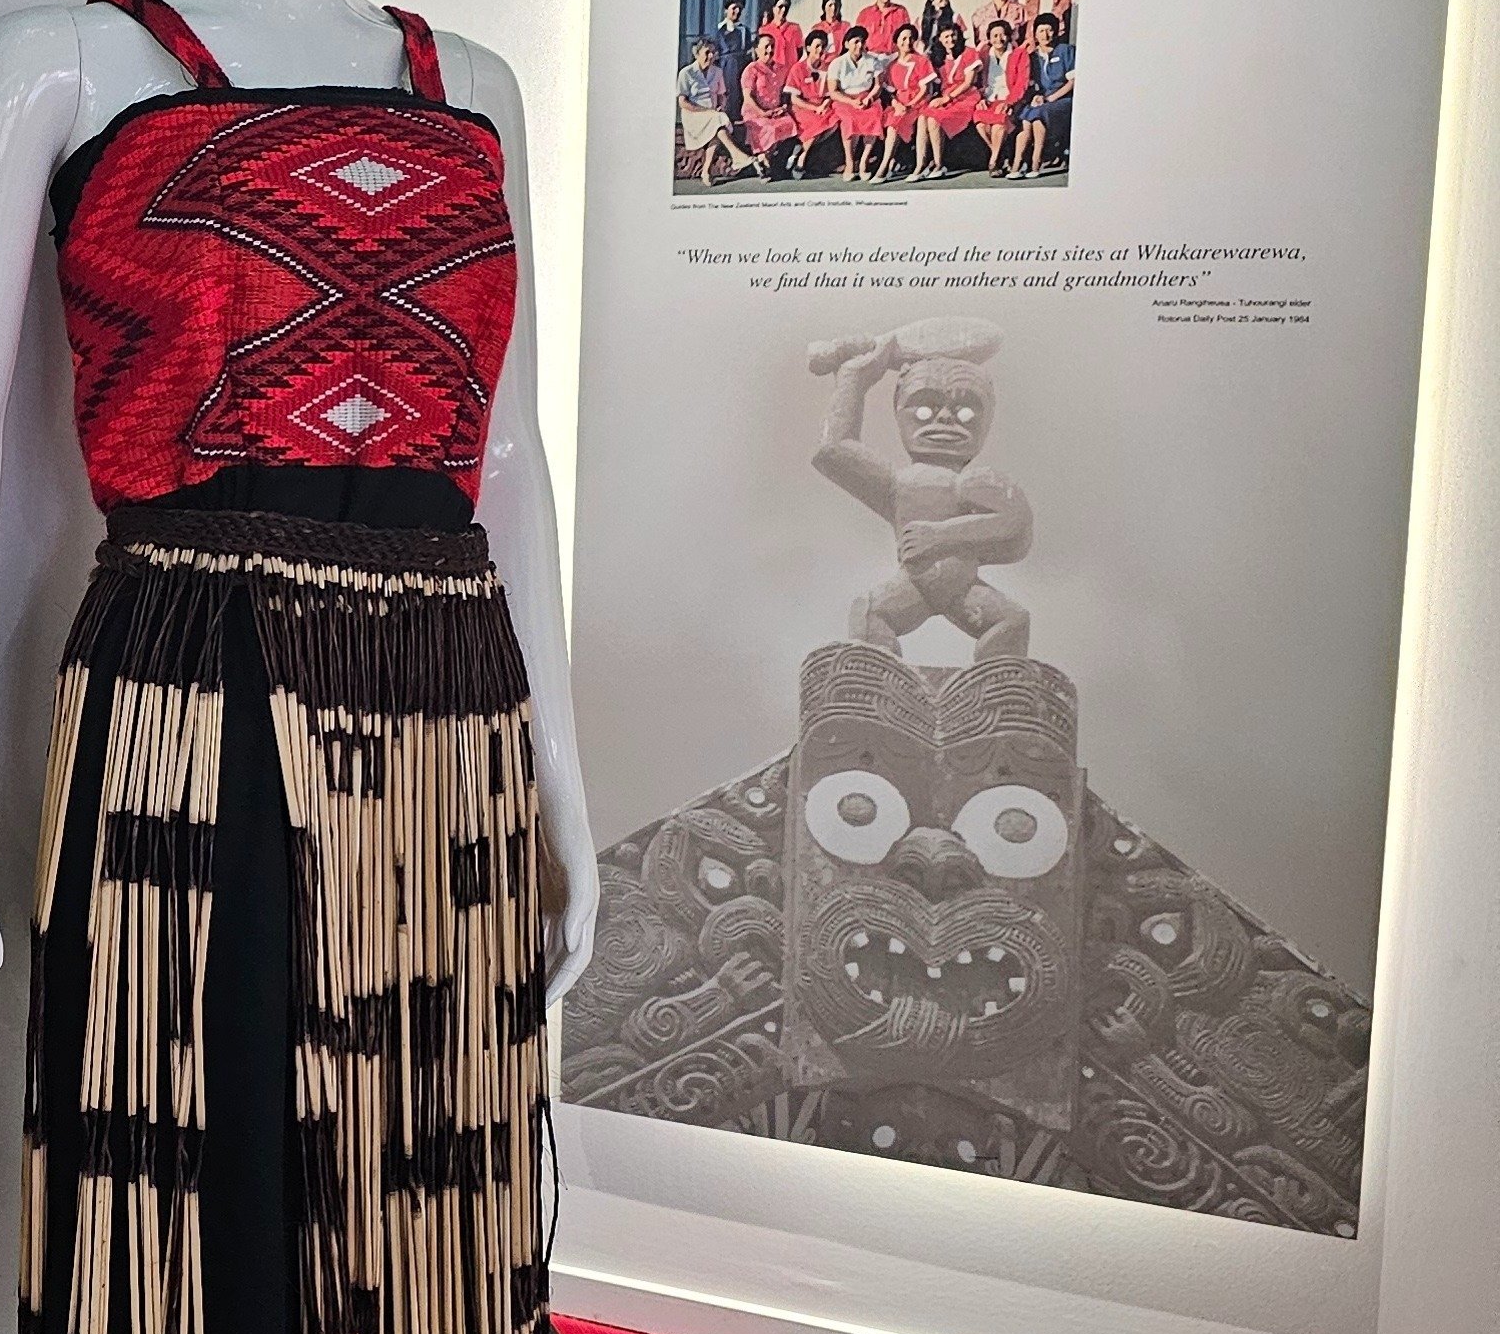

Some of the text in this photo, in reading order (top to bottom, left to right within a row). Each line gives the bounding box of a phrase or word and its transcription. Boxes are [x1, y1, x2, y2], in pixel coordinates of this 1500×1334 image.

[677, 243, 1305, 267] “When we look at who developed the tourist sites at Whakarewarewa,
[750, 269, 1211, 292] we find that it was our mothers and grandmothers”
